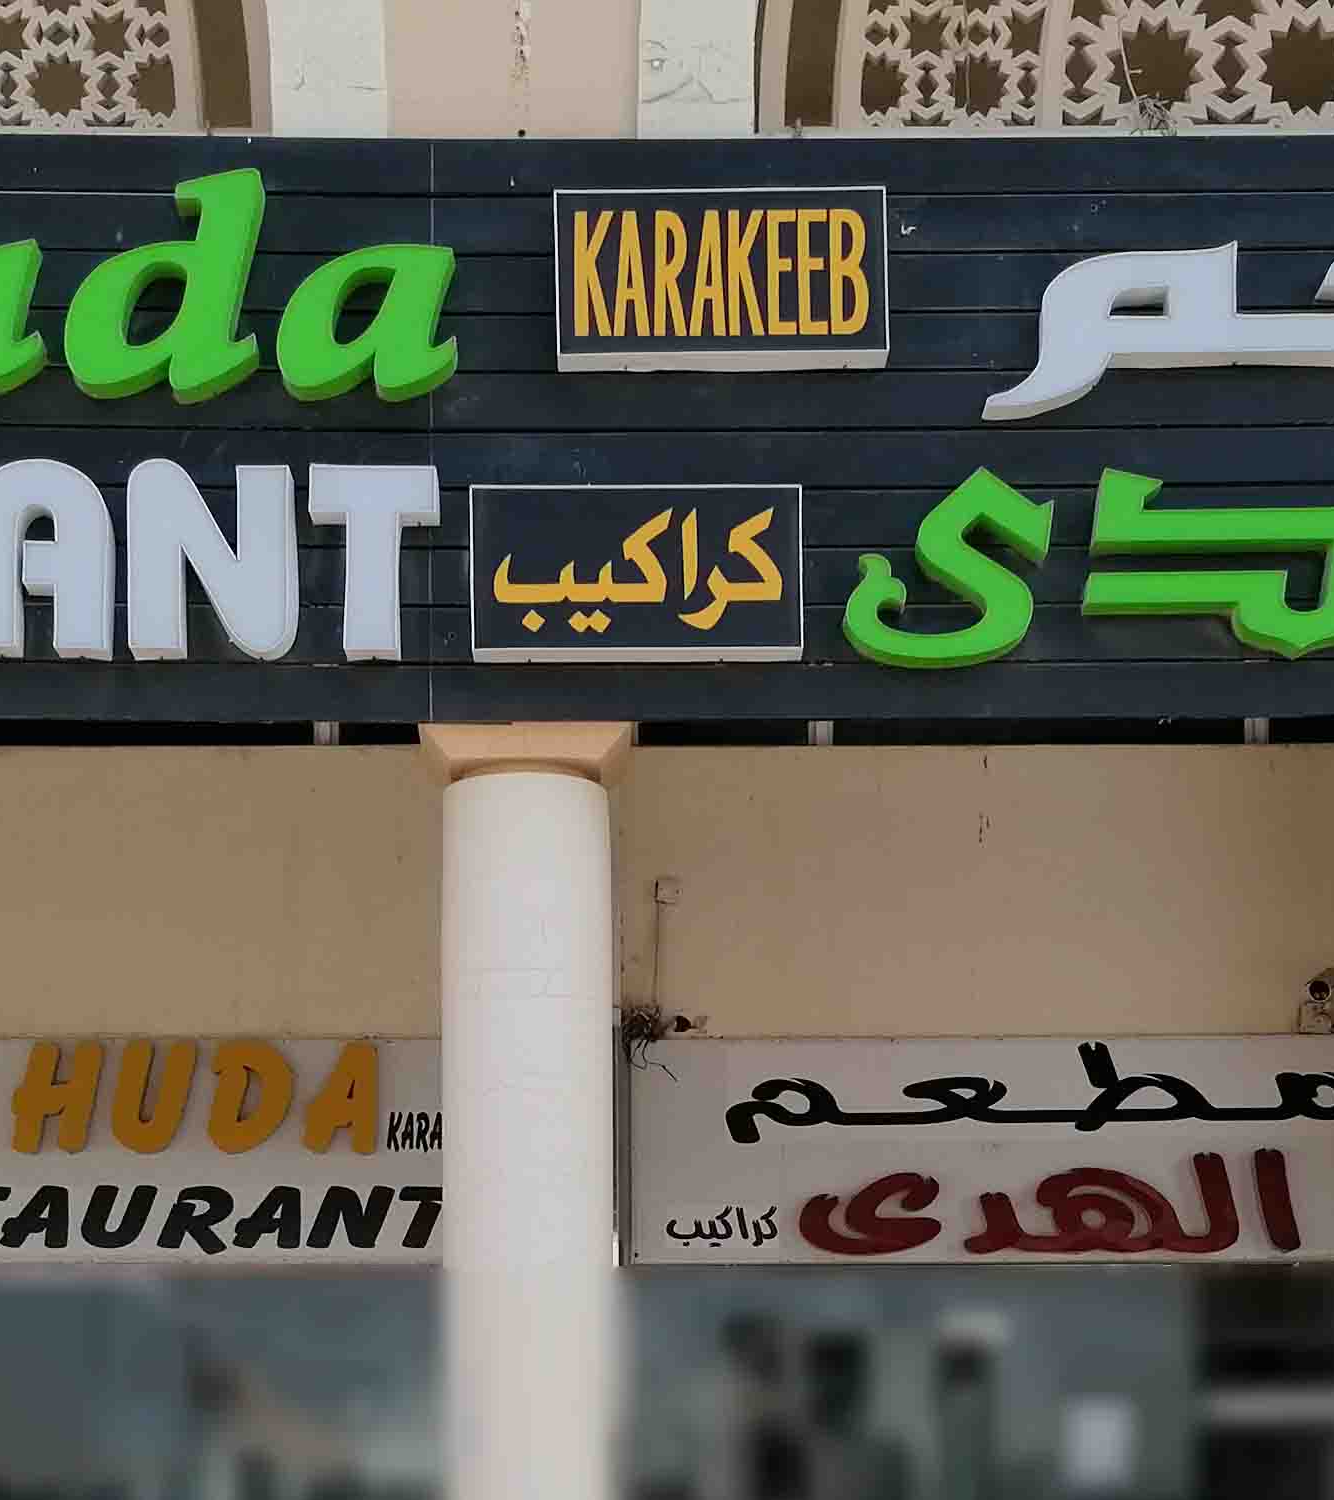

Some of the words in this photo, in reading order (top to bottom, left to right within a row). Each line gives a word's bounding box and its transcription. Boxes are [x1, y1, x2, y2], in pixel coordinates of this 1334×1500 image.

[572, 207, 870, 337] KARAKEEB
[492, 506, 784, 633] كراكيب
[10, 1037, 380, 1155] HUDA
[666, 1205, 778, 1248] كراكيب
